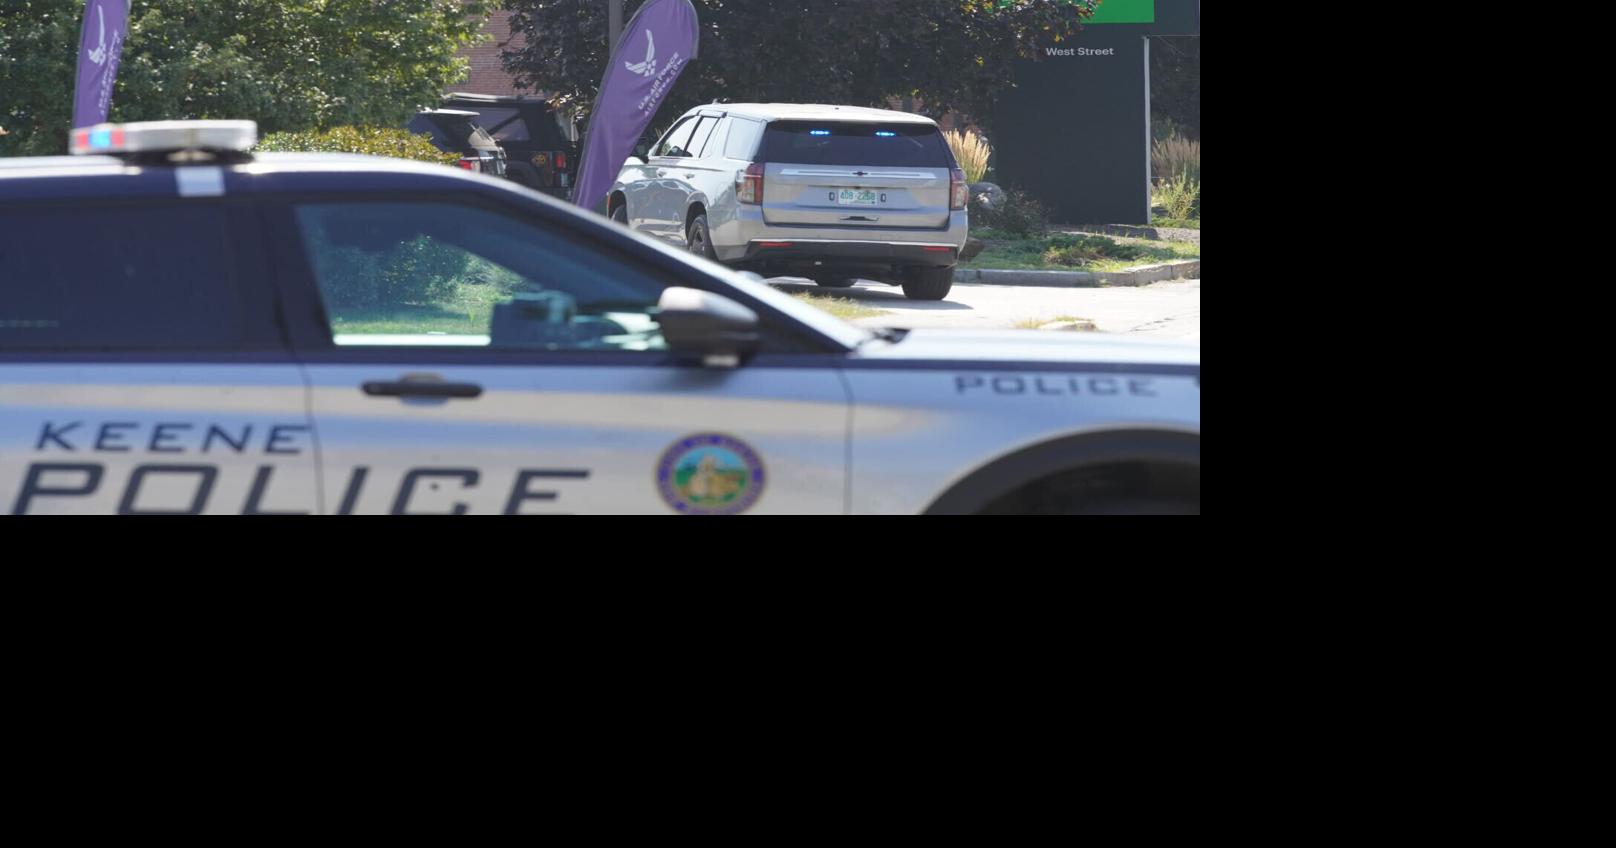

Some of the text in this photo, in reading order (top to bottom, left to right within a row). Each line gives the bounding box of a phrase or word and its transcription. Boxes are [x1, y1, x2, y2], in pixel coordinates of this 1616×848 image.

[1045, 47, 1114, 56] West Street
[954, 374, 1158, 397] POLICE
[35, 421, 311, 453] KEENE
[11, 462, 592, 515] POLICE
